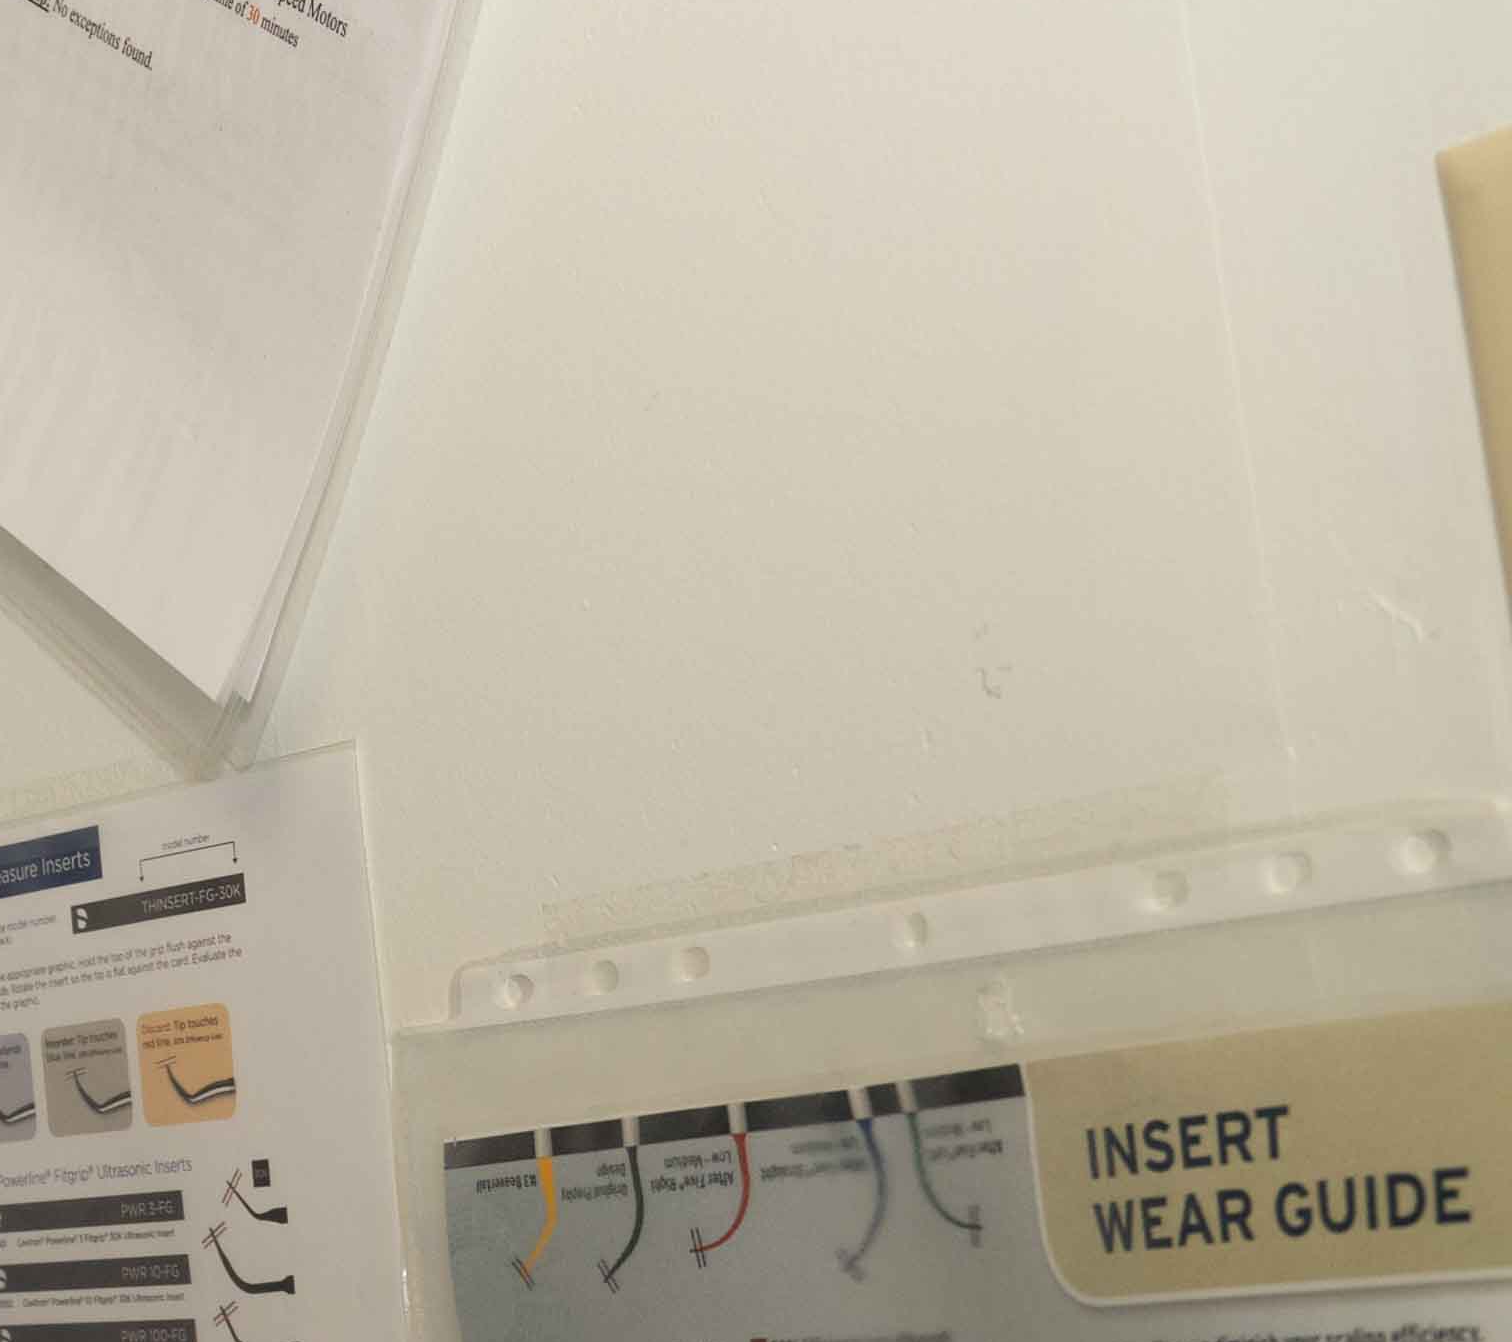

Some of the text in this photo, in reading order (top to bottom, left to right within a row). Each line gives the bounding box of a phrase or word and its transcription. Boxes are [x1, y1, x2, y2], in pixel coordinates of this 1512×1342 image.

[70, 10, 120, 49] exceptions
[122, 37, 152, 70] found.
[235, 1, 248, 17] of
[247, 5, 260, 24] 30
[261, 17, 298, 47] minutes
[42, 852, 90, 875] Inserts
[1087, 1105, 1290, 1179] INSERT
[1093, 1166, 1471, 1254] WEAR GUIDE
